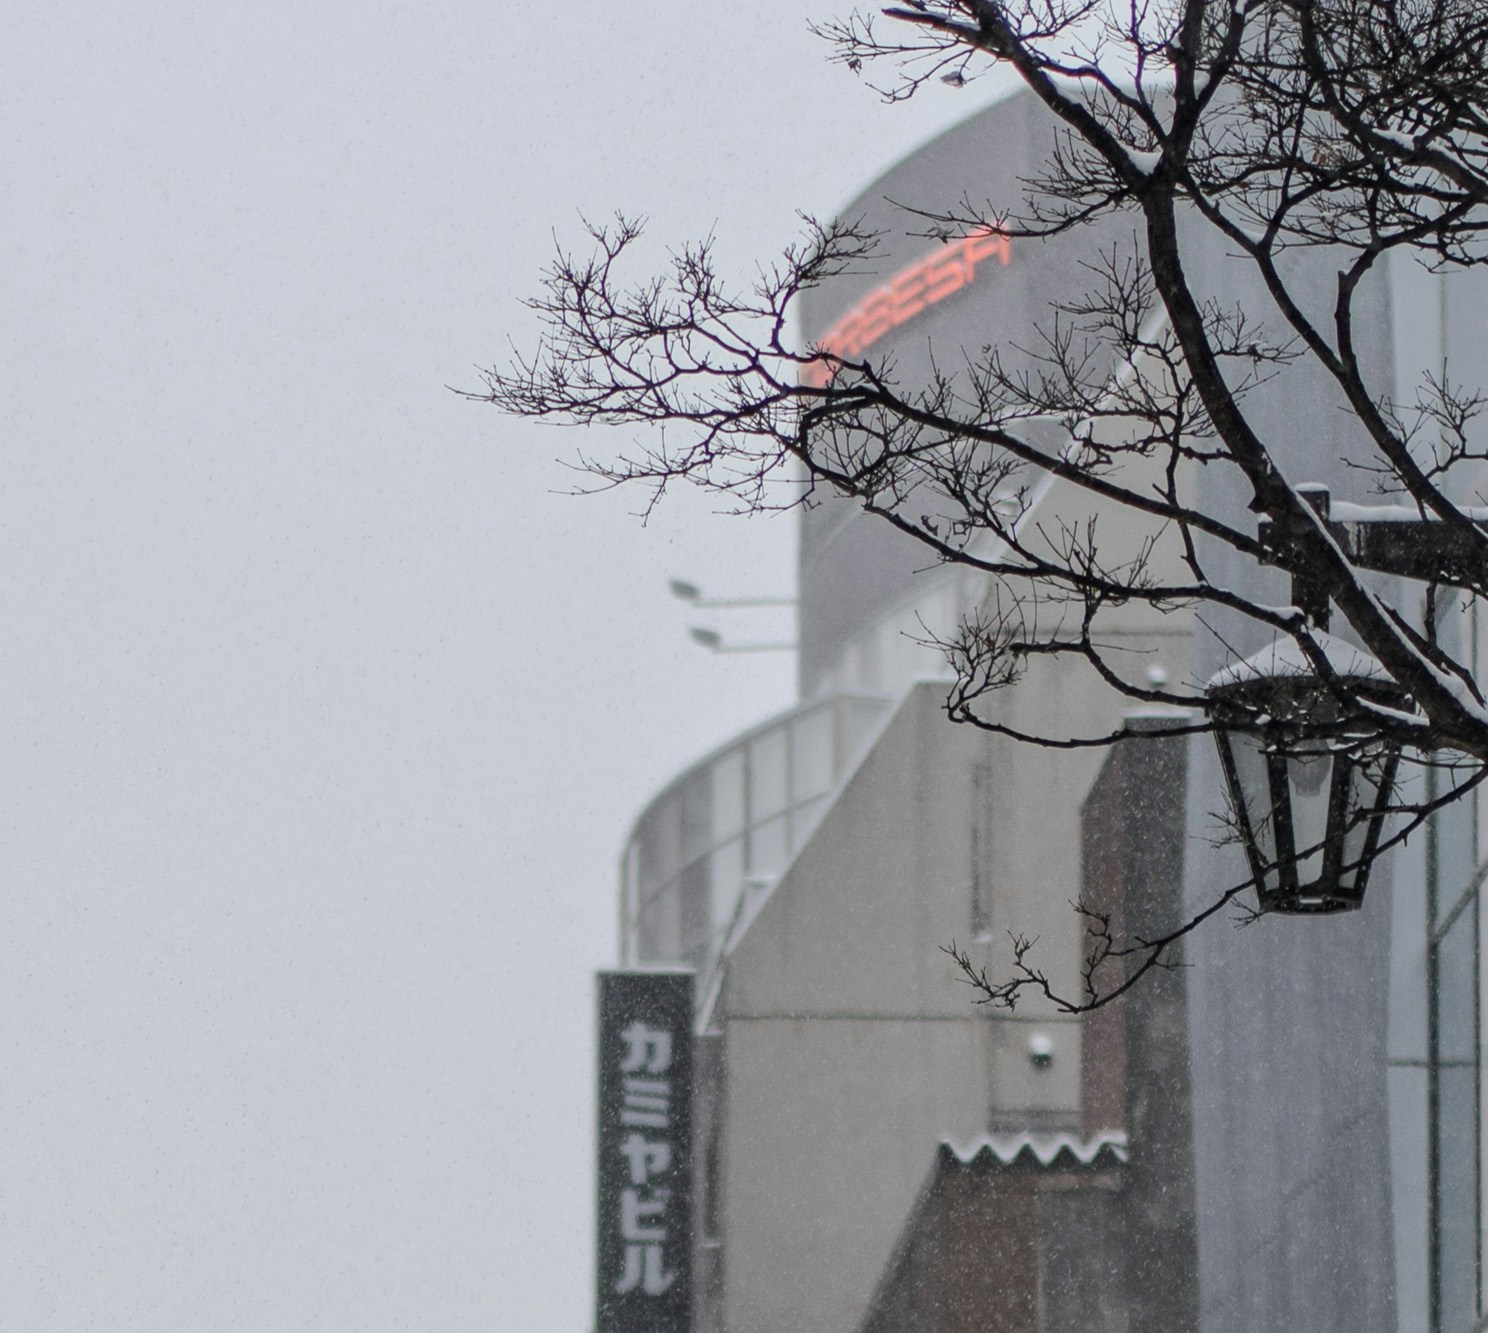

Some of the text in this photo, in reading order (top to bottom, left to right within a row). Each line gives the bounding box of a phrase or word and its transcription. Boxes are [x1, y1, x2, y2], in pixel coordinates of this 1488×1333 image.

[614, 1019, 676, 1297] カミヤビル
